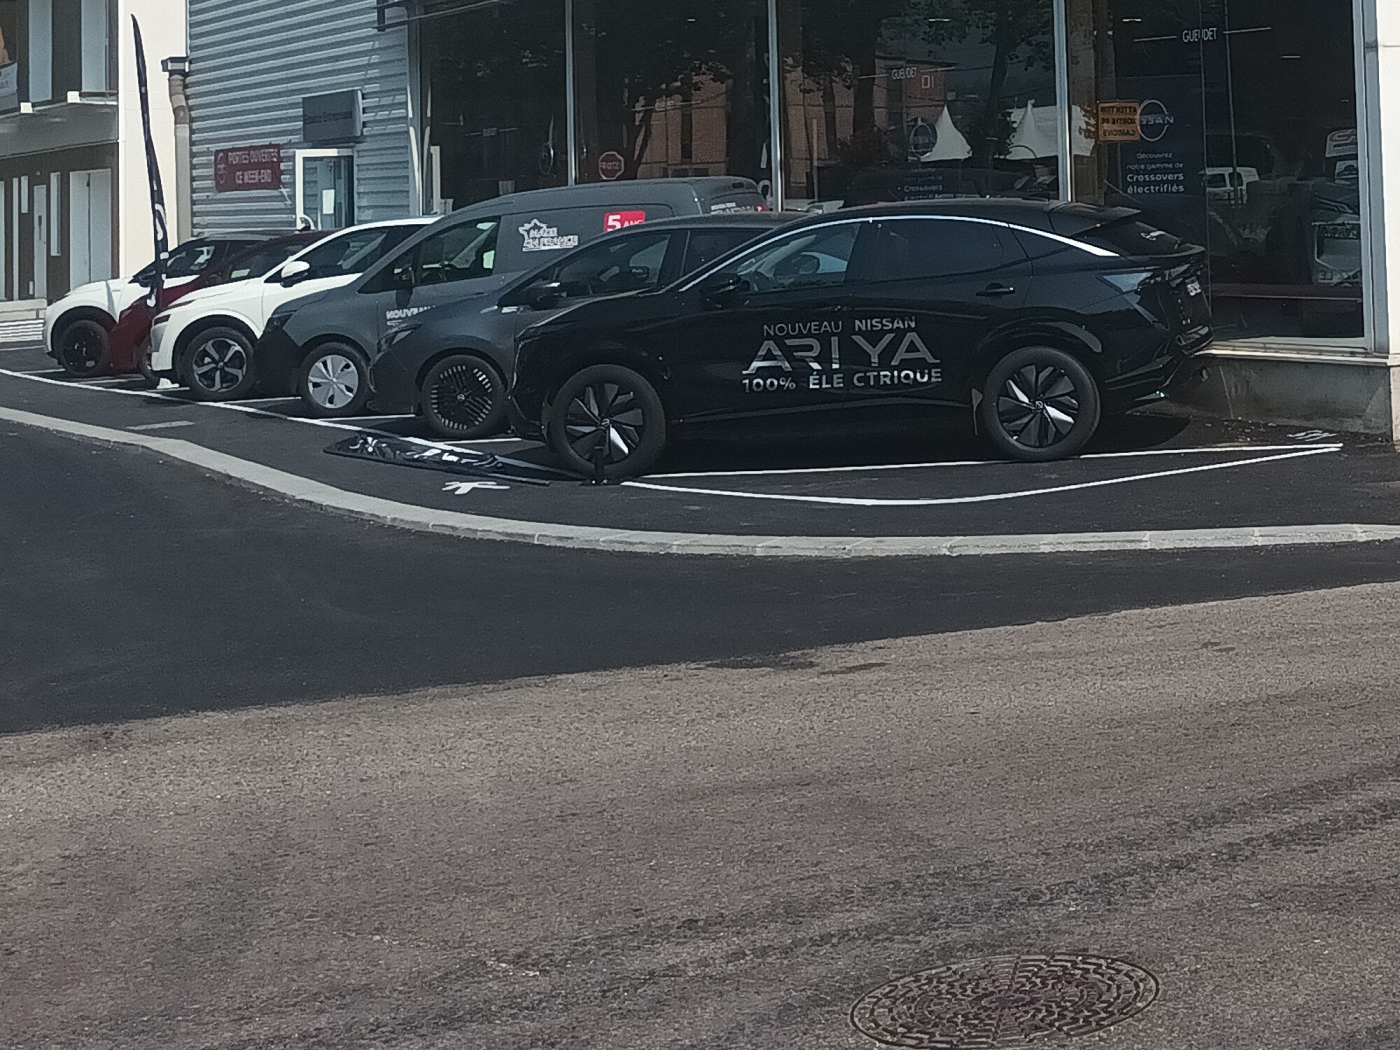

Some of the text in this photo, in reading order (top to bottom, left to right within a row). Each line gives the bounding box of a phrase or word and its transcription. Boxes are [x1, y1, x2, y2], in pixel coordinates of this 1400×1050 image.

[1126, 172, 1184, 182] Crossovers
[1127, 183, 1185, 194] électrifiés
[606, 215, 621, 231] 5
[763, 316, 916, 336] NOUVEAU NISSAN
[742, 377, 797, 393] 100%
